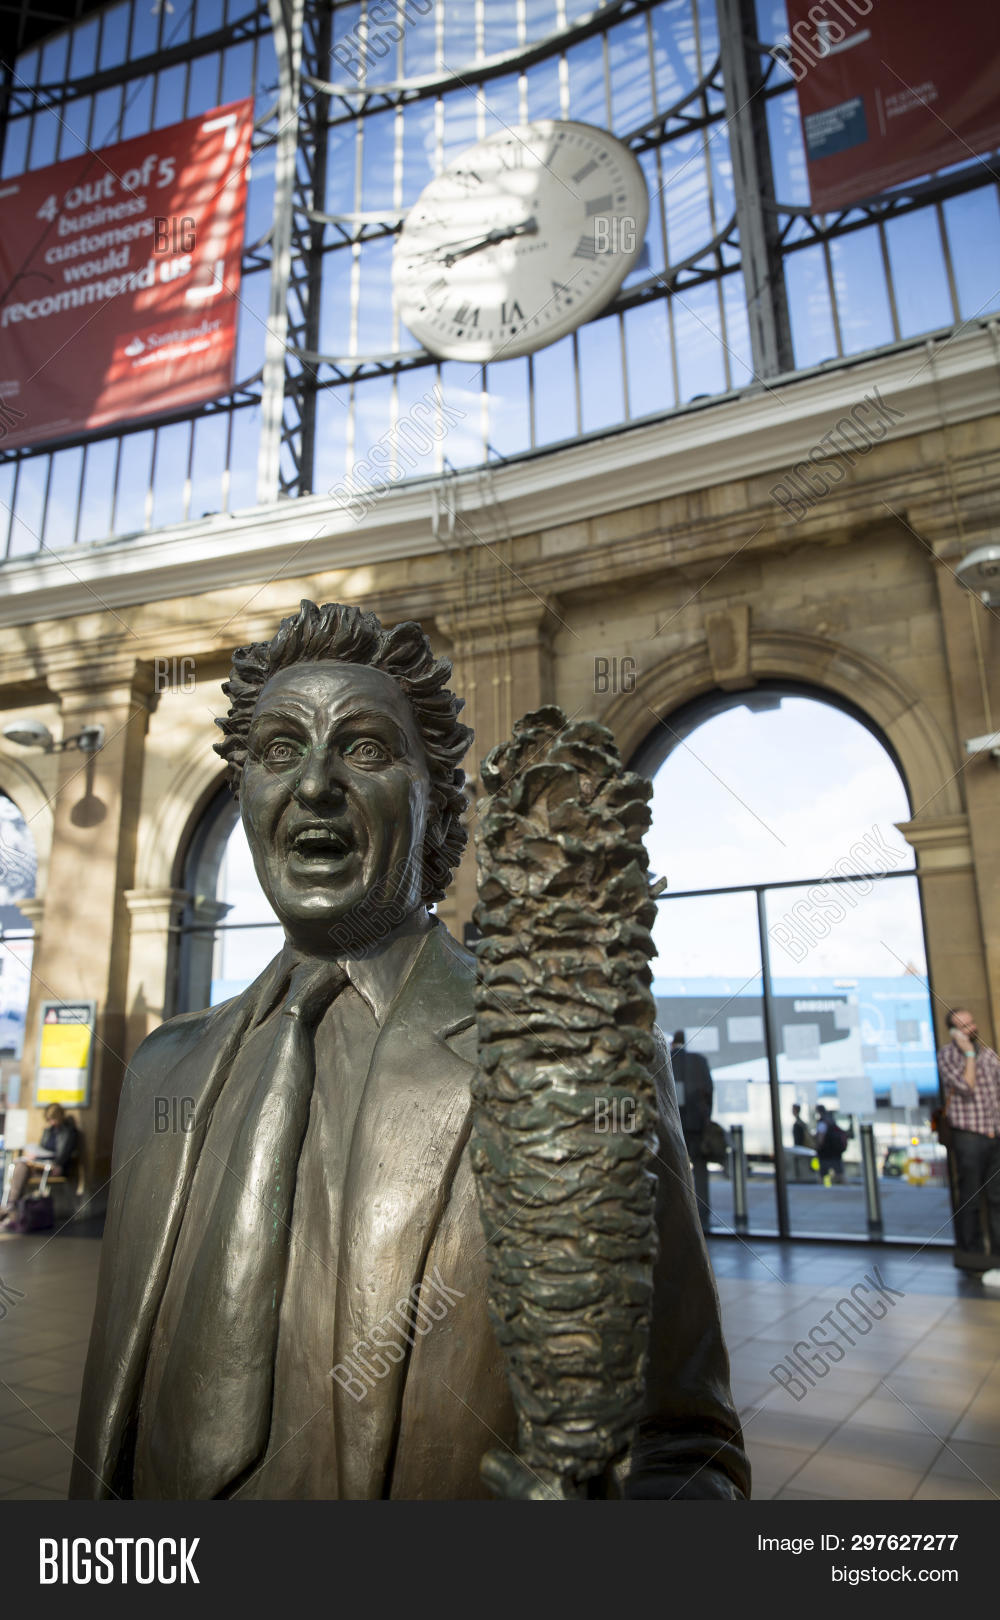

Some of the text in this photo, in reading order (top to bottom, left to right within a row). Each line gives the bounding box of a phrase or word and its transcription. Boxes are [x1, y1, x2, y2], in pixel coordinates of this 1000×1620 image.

[36, 154, 176, 222] 4 out of 5
[58, 195, 147, 237] business
[45, 218, 154, 265] customers
[63, 246, 130, 283] would
[1, 254, 193, 328] recommend us
